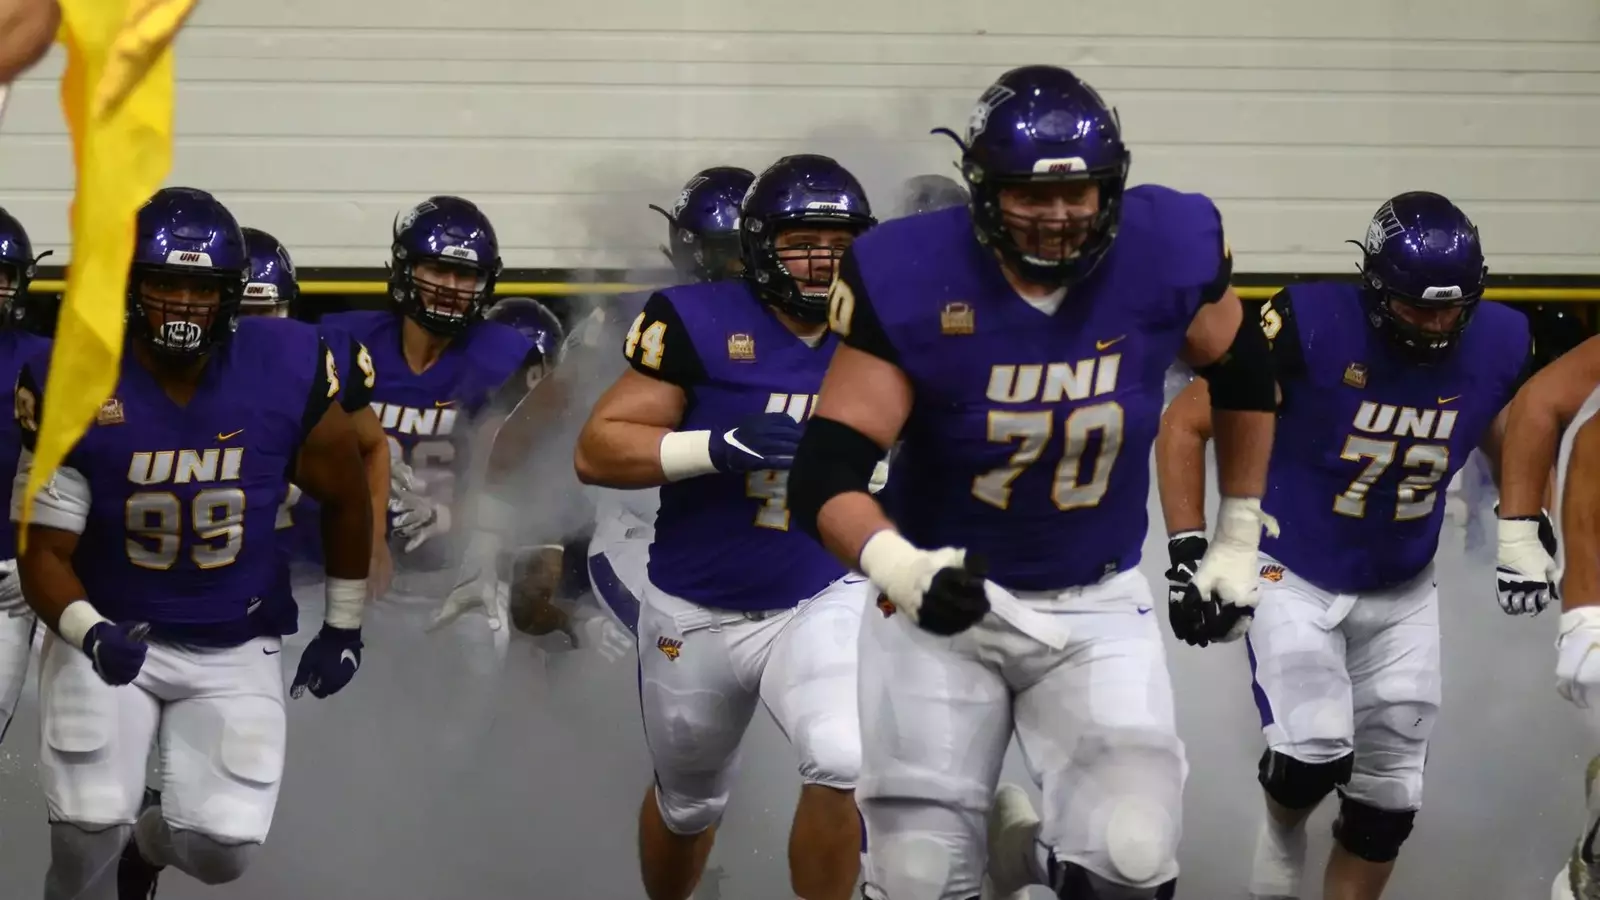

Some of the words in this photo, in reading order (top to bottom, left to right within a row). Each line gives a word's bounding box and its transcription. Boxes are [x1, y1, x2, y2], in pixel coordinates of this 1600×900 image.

[1048, 162, 1073, 173] UNI
[179, 252, 201, 263] UNI
[452, 248, 469, 258] UNI
[246, 285, 264, 295] UNI
[1435, 288, 1454, 298] UNI
[985, 352, 1122, 403] UNI
[1352, 400, 1459, 440] UNI
[127, 446, 245, 486] UNI
[970, 400, 1125, 512] 70
[1332, 434, 1450, 521] 72
[125, 488, 246, 571] 99
[656, 635, 684, 650] UNI
